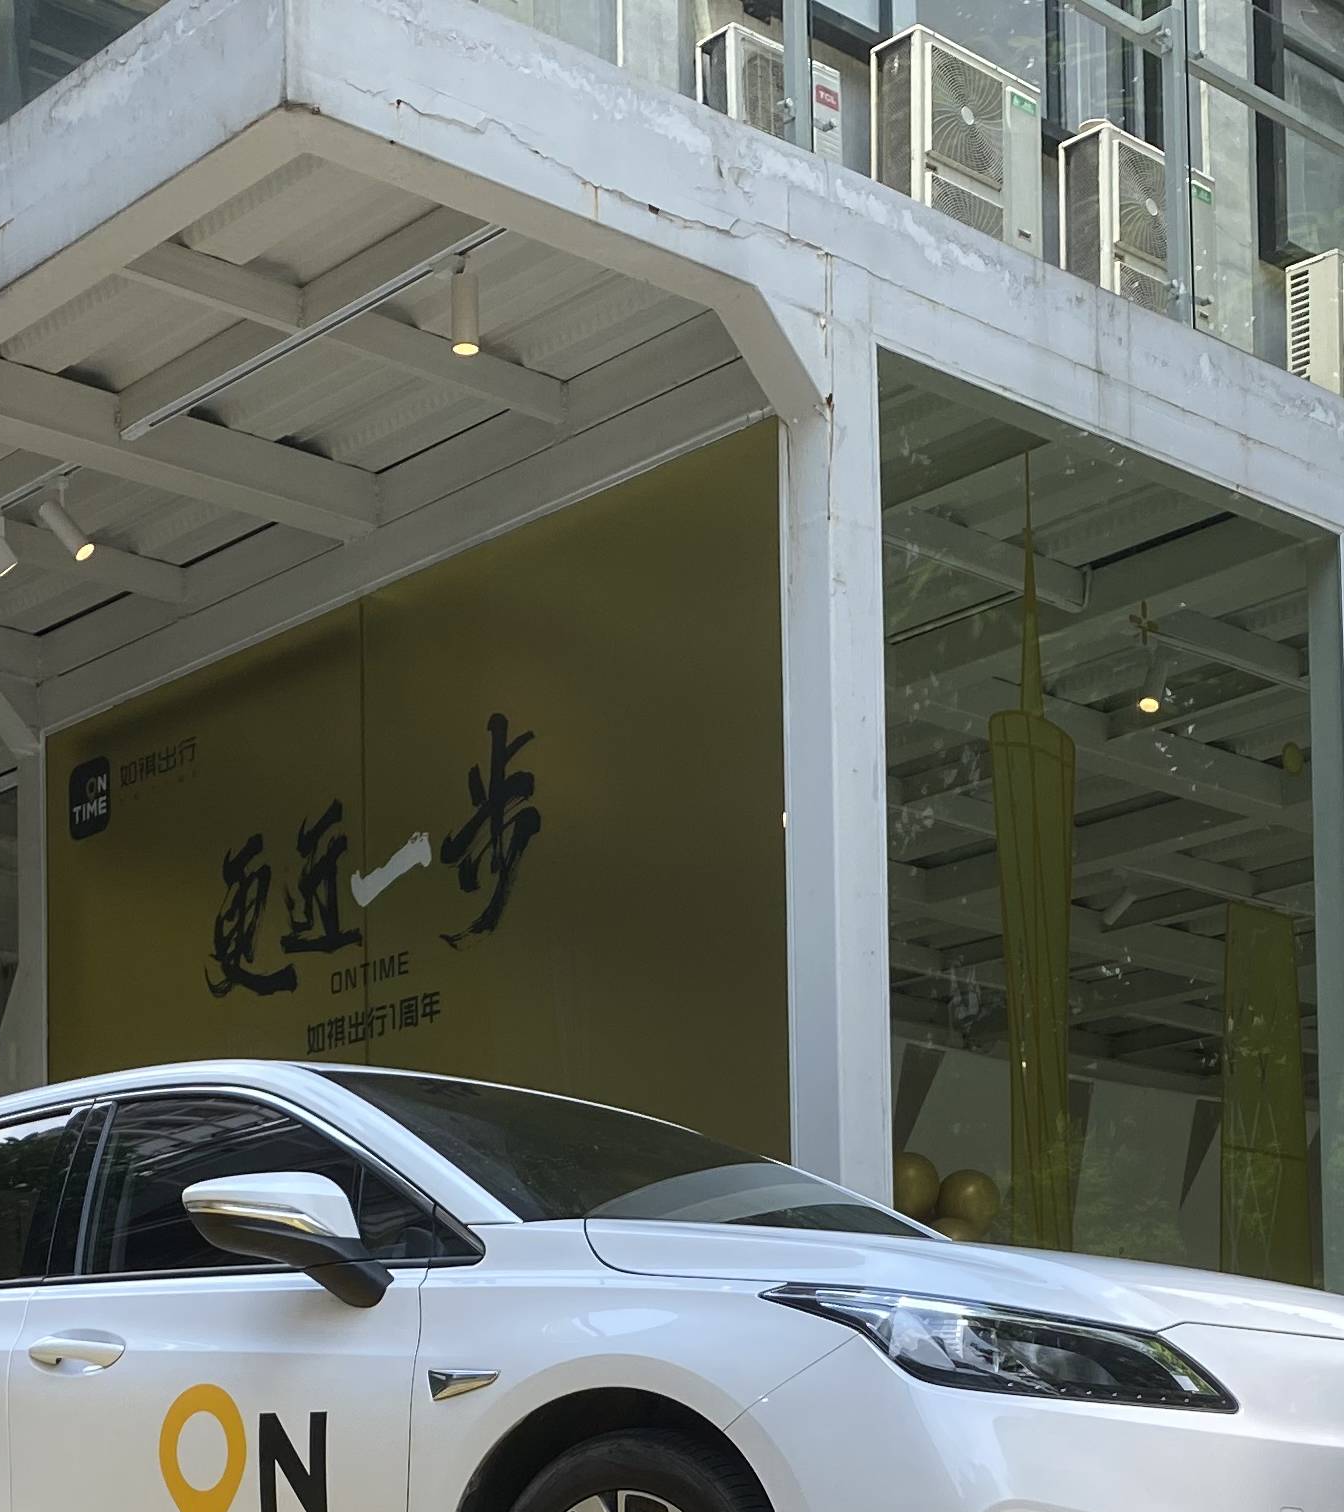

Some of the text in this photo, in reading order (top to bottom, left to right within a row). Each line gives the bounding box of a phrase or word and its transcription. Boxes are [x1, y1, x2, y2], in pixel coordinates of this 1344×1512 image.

[818, 90, 837, 106] TCL
[120, 735, 198, 788] 如祺出行
[86, 774, 107, 800] ON
[72, 795, 107, 825] TIME
[205, 712, 543, 998] 更近一步
[330, 951, 410, 995] ONTIME
[306, 991, 441, 1055] 如祺出行1周年
